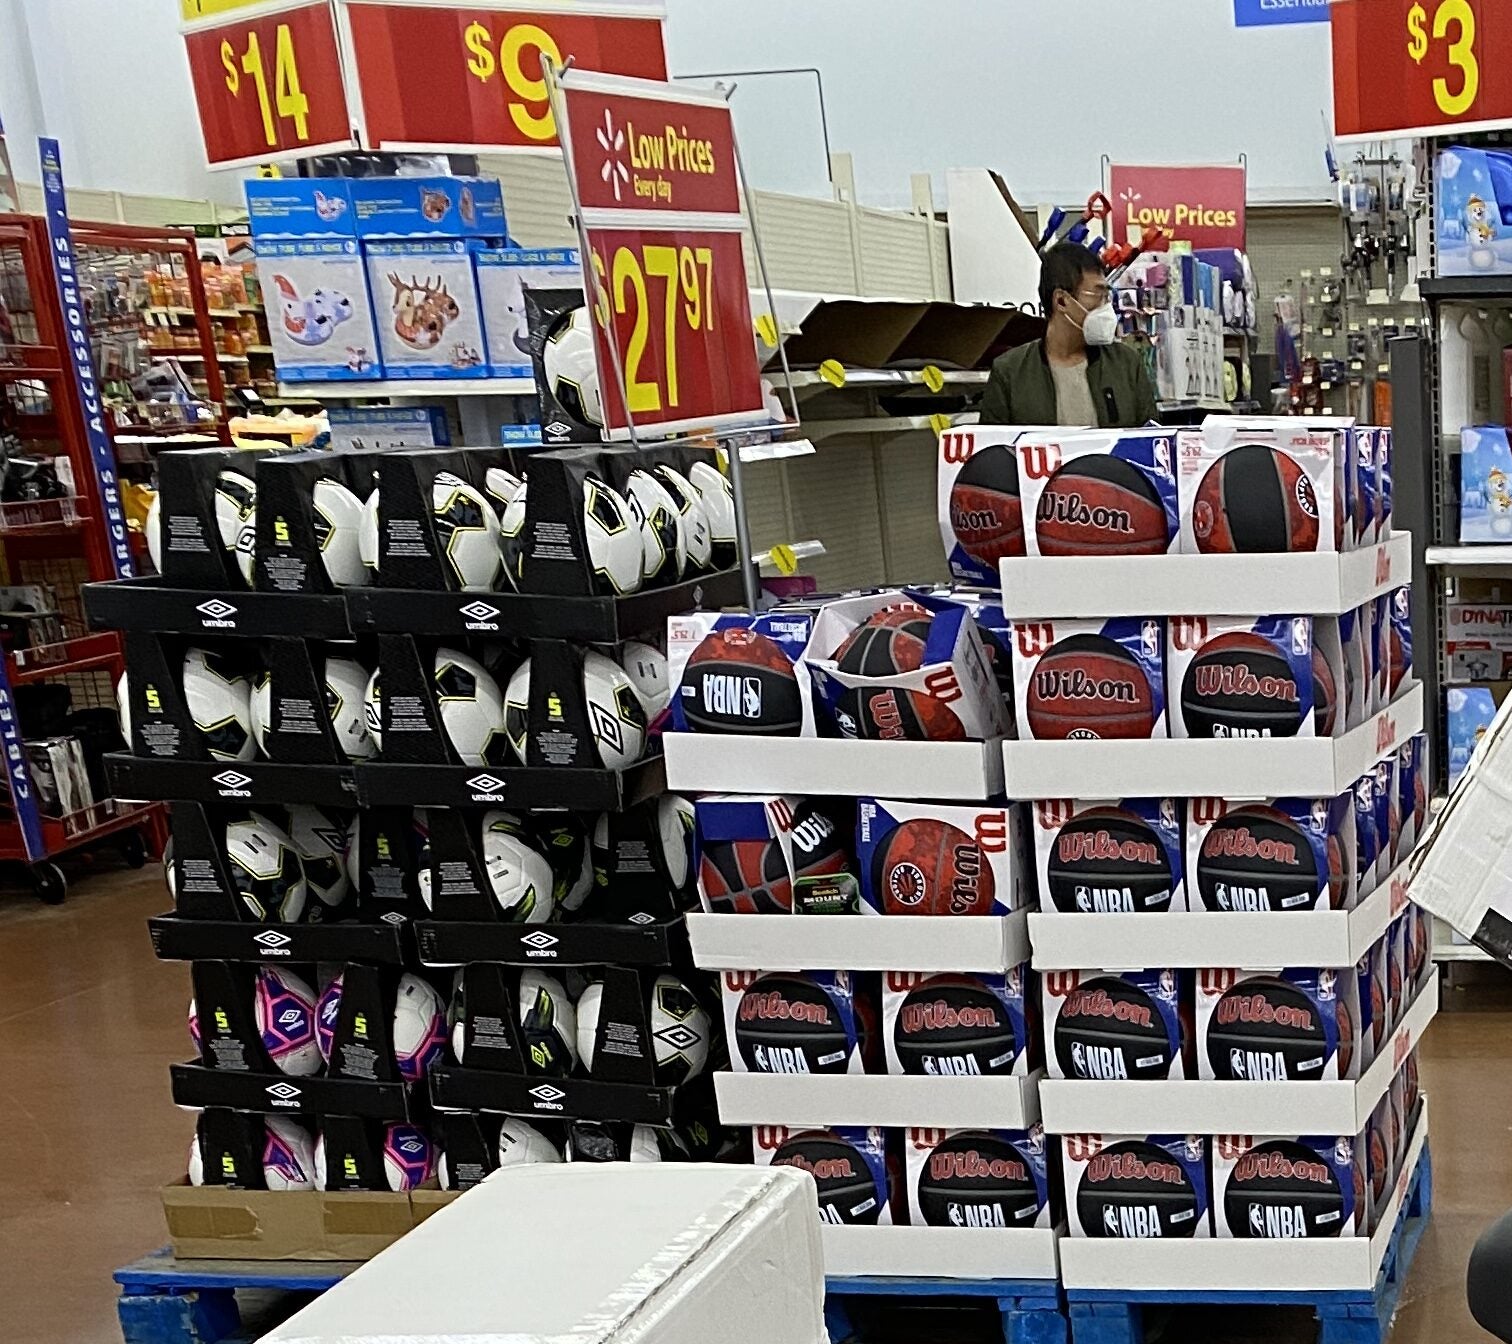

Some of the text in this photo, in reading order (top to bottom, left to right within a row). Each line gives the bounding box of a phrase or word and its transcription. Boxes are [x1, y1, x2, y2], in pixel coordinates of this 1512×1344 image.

[1407, 0, 1478, 115] $3
[220, 24, 308, 146] $14
[627, 121, 715, 174] Low Prices
[633, 174, 672, 203] Every day
[1128, 202, 1236, 226] Low Prices
[56, 237, 104, 433] ACCESSORIES
[102, 468, 133, 579] ARGERS
[1037, 492, 1135, 533] Wilson
[202, 619, 235, 628] umbro
[466, 621, 499, 630] umbro
[1036, 668, 1139, 704] Wilson
[1195, 664, 1300, 701] Wilson
[219, 789, 251, 797] umbro
[1204, 828, 1299, 865] Wilson
[741, 991, 832, 1025] Wilson
[1063, 990, 1154, 1028] Wilson
[1247, 1052, 1287, 1080] NBA
[931, 1151, 1028, 1182] Wilson
[1087, 1152, 1185, 1185] Wilson
[1235, 1151, 1332, 1185] Wilson
[1120, 1206, 1161, 1237] NBA
[1266, 1206, 1306, 1237] NBA
